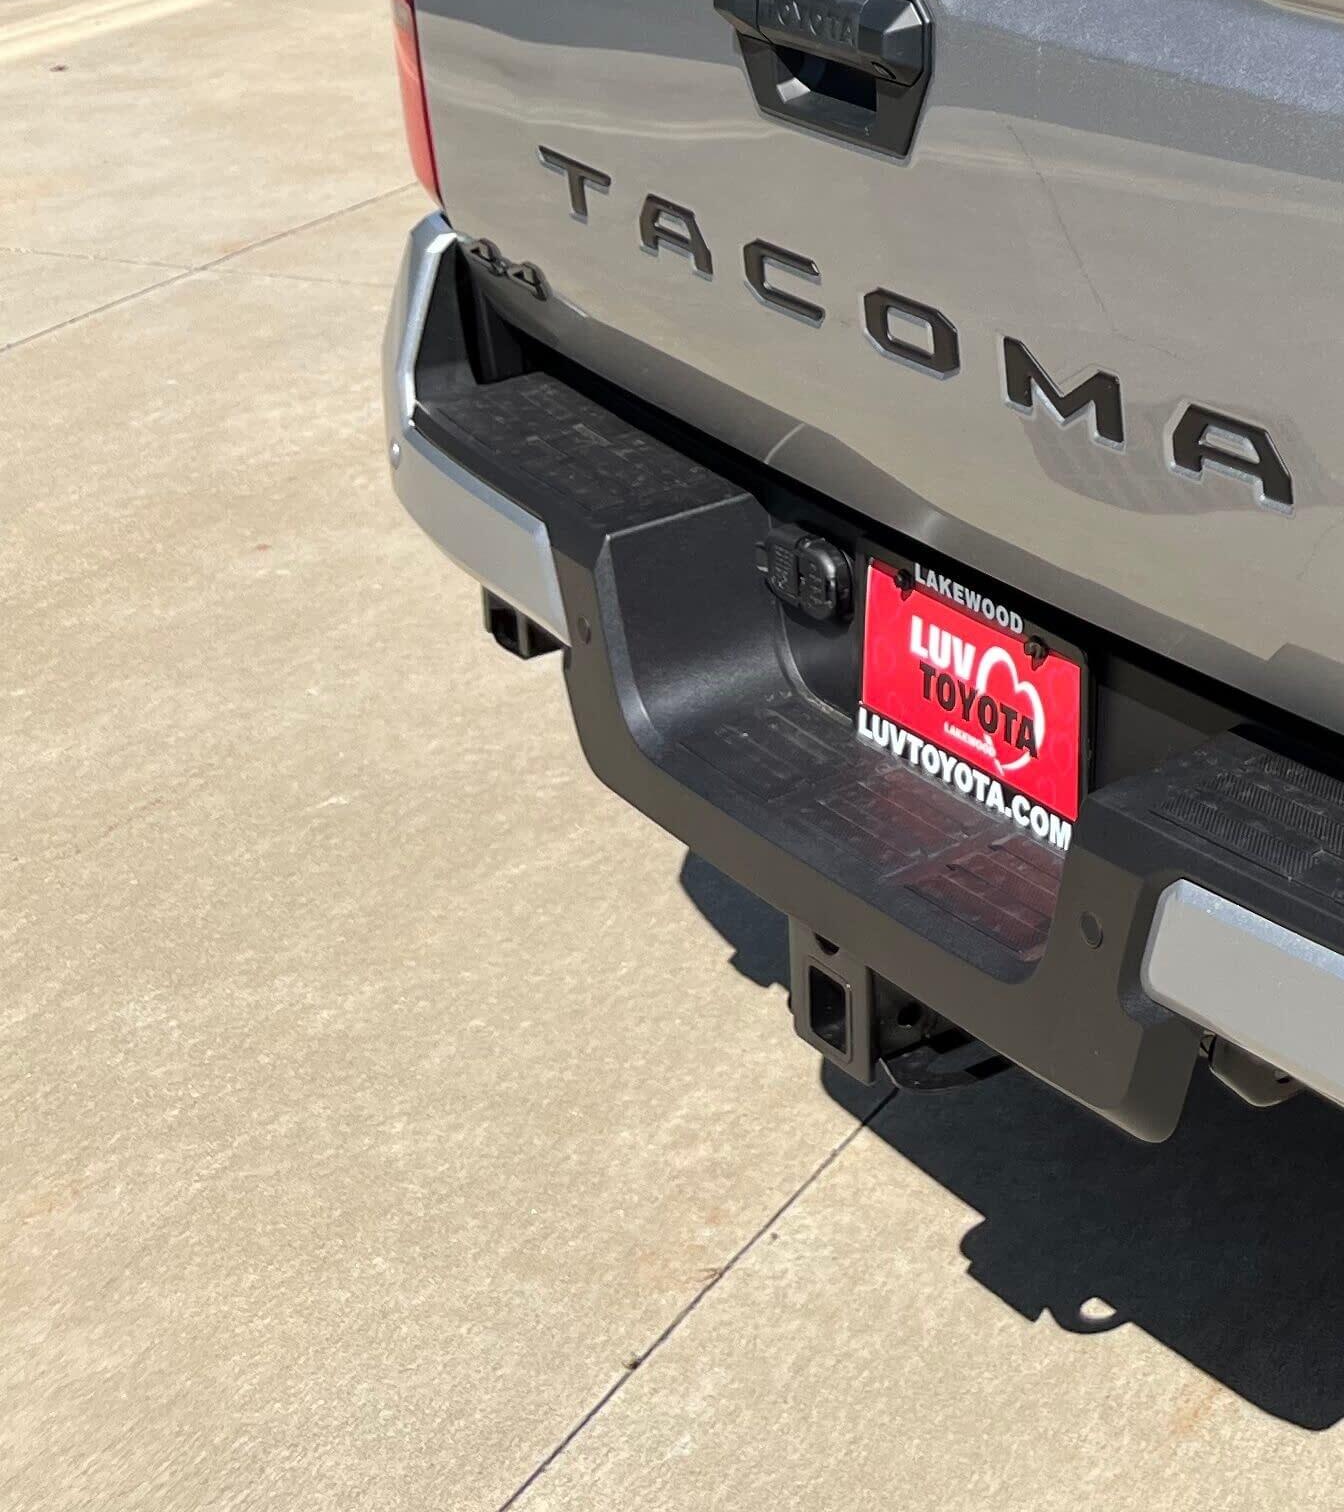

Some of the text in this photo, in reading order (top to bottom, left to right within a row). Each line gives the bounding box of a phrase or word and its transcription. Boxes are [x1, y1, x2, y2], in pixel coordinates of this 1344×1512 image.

[536, 144, 1295, 515] TACOMA
[914, 562, 1025, 635] LAKEWOOD
[909, 615, 977, 681] LUV
[919, 659, 1039, 759] TOYOTA
[942, 720, 997, 758] LAKEWOOD
[857, 706, 1073, 852] LUVTOYOTA.COM
